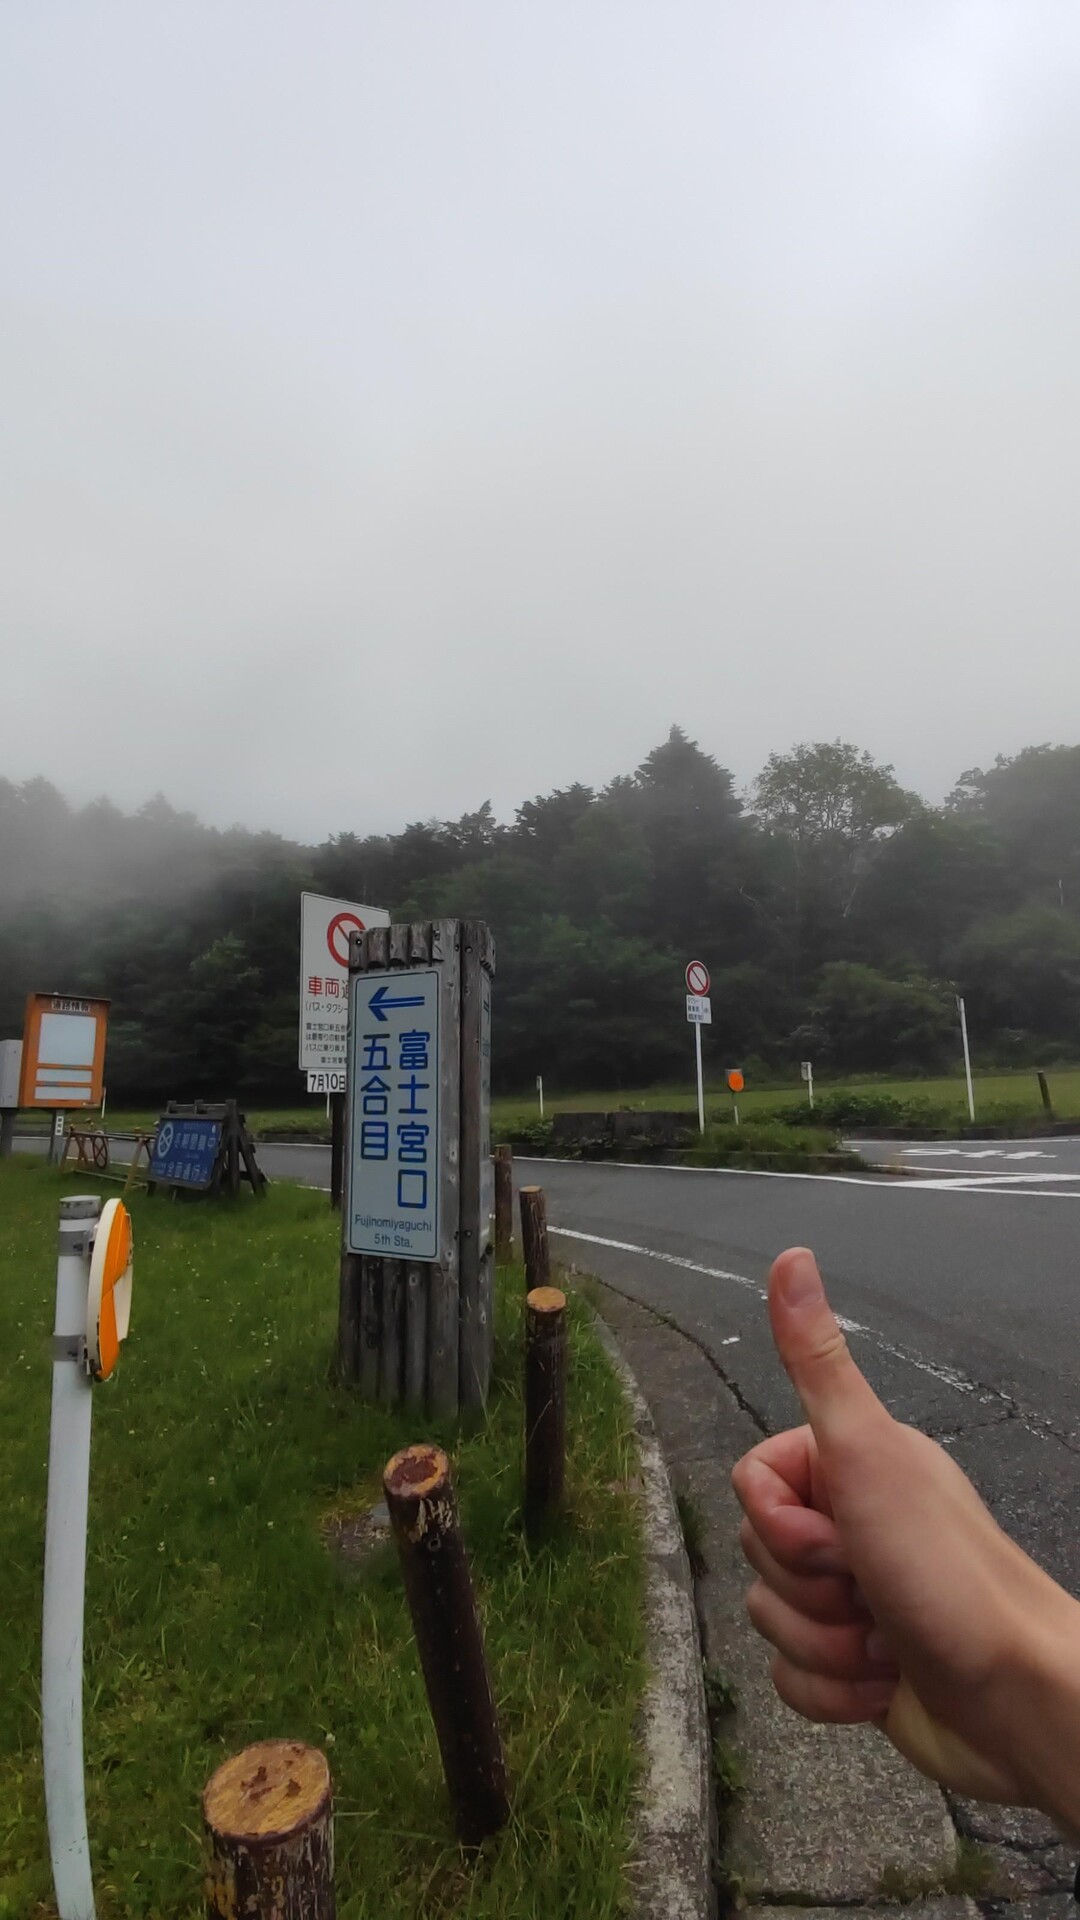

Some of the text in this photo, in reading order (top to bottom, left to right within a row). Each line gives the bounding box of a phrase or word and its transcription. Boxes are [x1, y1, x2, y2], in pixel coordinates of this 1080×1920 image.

[360, 1033, 392, 1161] 五合目
[397, 1029, 430, 1209] 富士宮口
[354, 1214, 432, 1232] Fujinomiyaguchi
[374, 1233, 413, 1249] 5th Sta.
